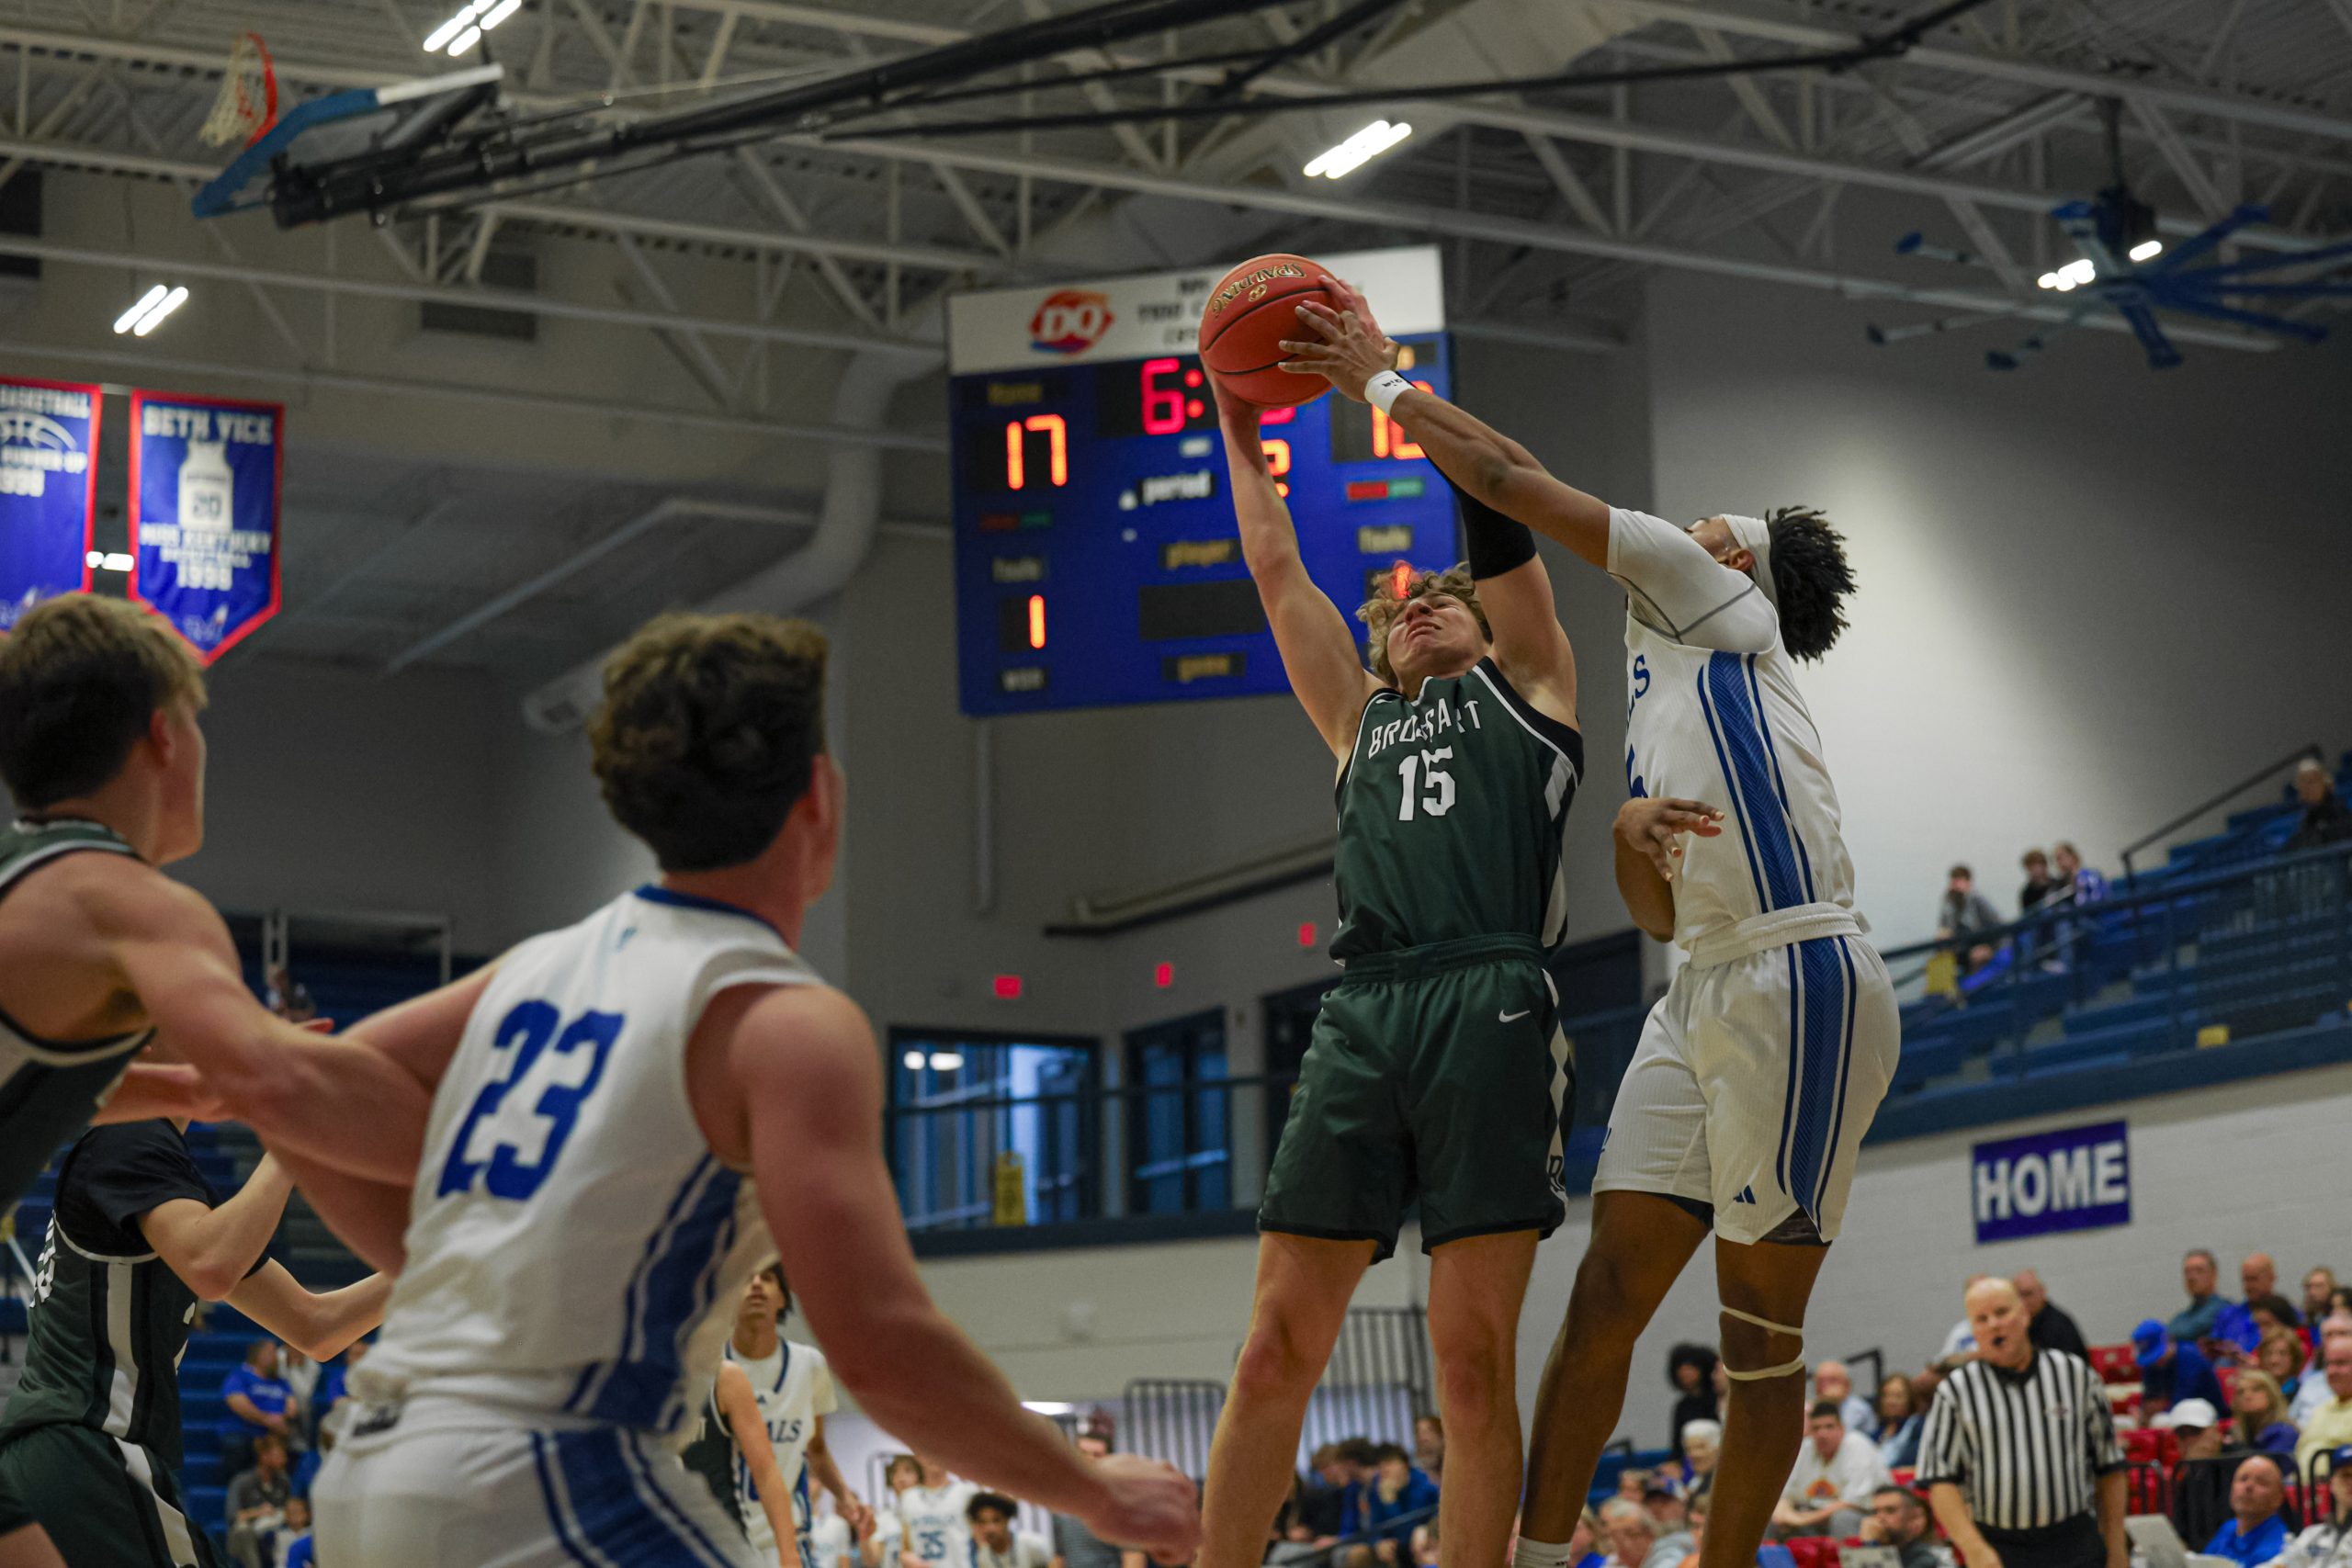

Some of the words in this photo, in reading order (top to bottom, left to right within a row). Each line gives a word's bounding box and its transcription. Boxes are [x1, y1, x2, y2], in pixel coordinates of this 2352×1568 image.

[1212, 263, 1306, 319] SPALDING
[143, 404, 210, 441] BETH
[217, 412, 273, 445] VICE
[1006, 413, 1069, 491] 17
[1029, 594, 1046, 649] 1
[1398, 745, 1455, 821] 15
[436, 998, 625, 1201] 23
[1976, 1139, 2127, 1223] HOME
